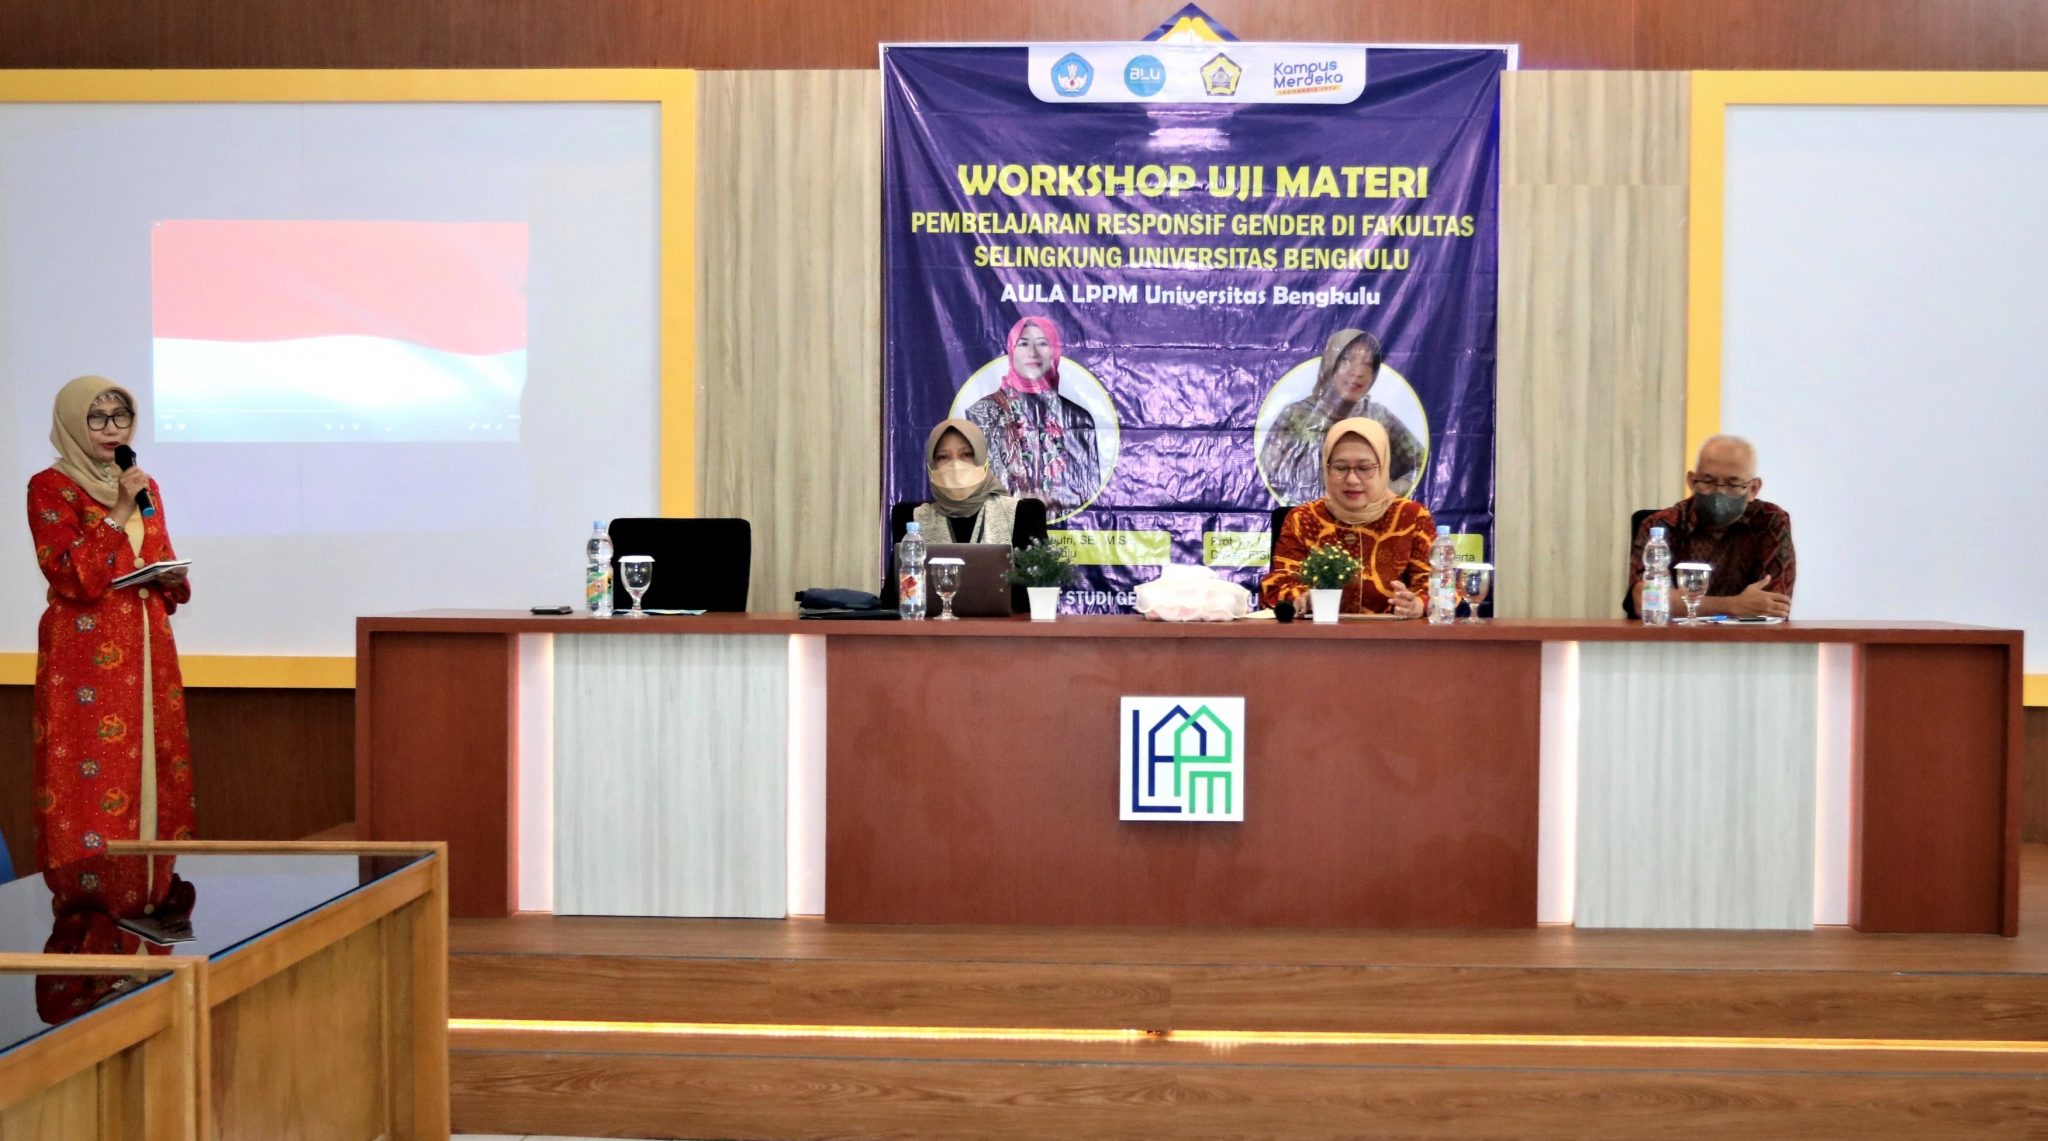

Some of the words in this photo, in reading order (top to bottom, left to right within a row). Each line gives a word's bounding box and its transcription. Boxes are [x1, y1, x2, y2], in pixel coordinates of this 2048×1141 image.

[1273, 61, 1337, 76] Kampus
[1273, 72, 1343, 89] Merdeka
[957, 165, 1196, 198] WORKSHOP
[1208, 165, 1263, 201] UJI
[1276, 166, 1429, 199] MATERI
[911, 211, 1090, 234] PEMBELAJARAN
[1097, 213, 1226, 236] RESPONSIF
[1231, 214, 1326, 236] GENDER
[1332, 215, 1354, 236] DI
[1362, 215, 1475, 238] FAKULTAS
[974, 245, 1122, 269] SELINGKUNG
[1129, 247, 1278, 270] UNIVERSITAS
[1284, 248, 1409, 271] BENGKULU
[1000, 283, 1067, 303] AULA
[1072, 284, 1138, 304] LPPM
[1145, 285, 1266, 305] Universitas
[1272, 286, 1381, 308] Bengkulu
[1065, 590, 1112, 606] STUDI
